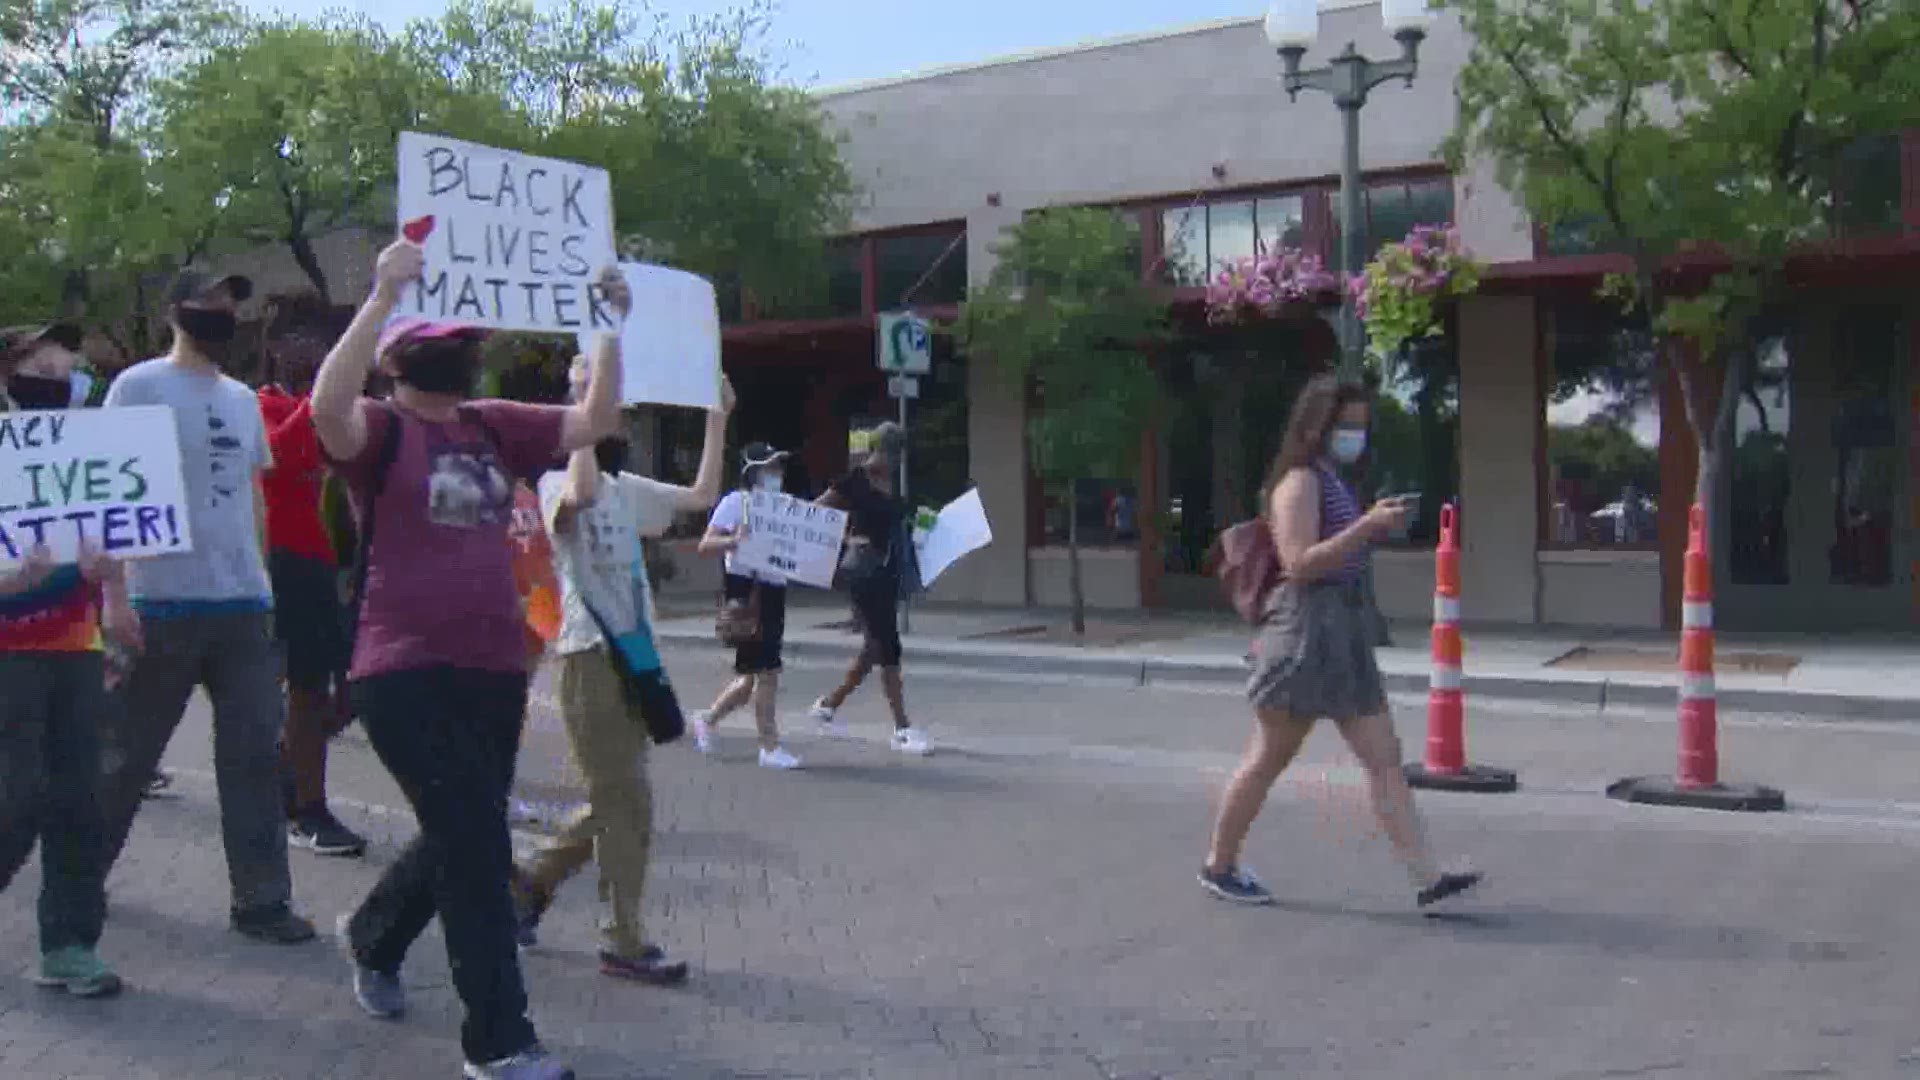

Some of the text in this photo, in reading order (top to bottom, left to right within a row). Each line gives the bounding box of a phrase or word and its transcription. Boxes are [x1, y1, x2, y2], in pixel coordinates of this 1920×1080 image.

[423, 146, 588, 227] BLACK
[447, 215, 588, 277] LIVES
[415, 271, 613, 328] MATTER
[0, 455, 148, 512] IVES
